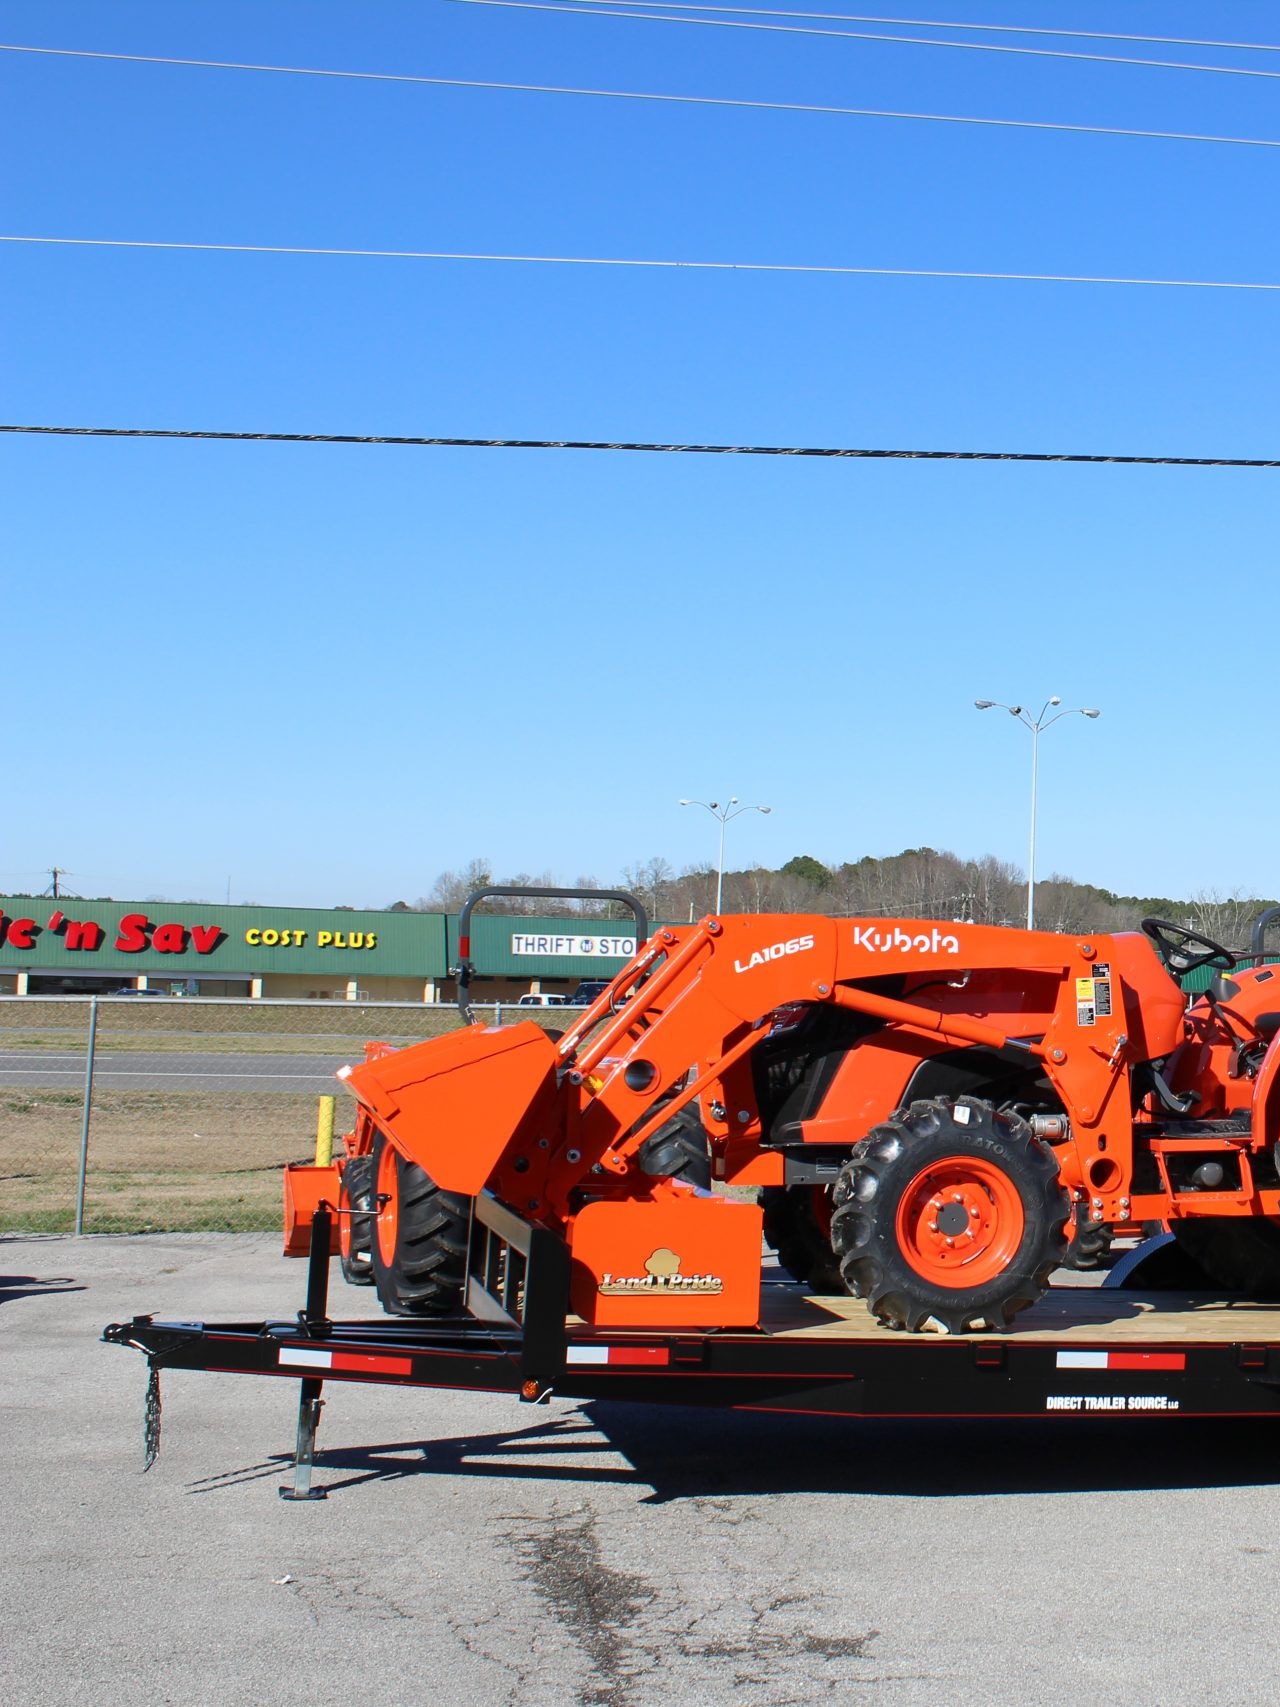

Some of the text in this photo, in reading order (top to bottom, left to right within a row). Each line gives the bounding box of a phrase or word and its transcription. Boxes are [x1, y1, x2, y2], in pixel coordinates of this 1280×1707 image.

[0, 908, 36, 949] c
[114, 913, 222, 953] Sav
[245, 928, 377, 949] COST PLUS
[853, 926, 959, 954] Kubota
[514, 936, 575, 953] THRIFT
[734, 934, 815, 974] LA1065
[600, 1273, 723, 1291] Land Pride
[1046, 1396, 1084, 1410] DIRECT
[1084, 1396, 1126, 1410] TRAILER
[1127, 1396, 1168, 1410] SOURCE
